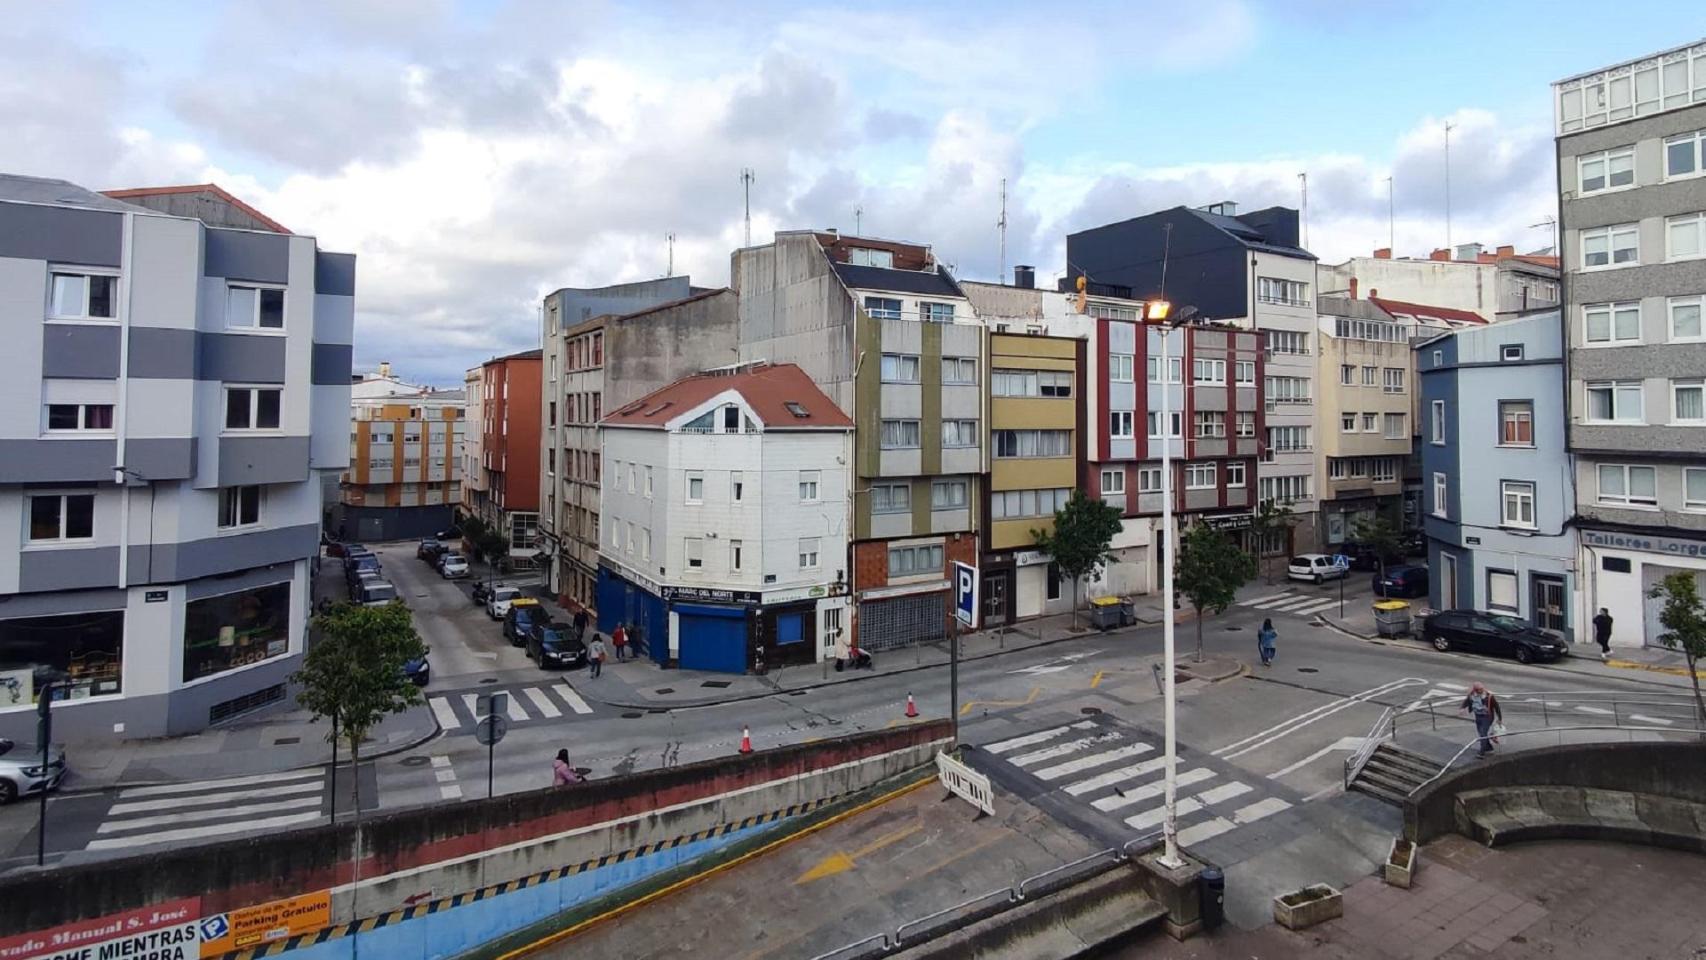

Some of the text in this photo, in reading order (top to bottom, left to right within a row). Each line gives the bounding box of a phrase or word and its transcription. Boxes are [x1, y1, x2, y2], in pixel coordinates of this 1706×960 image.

[1586, 532, 1651, 549] Talleres
[960, 569, 972, 604] P
[51, 920, 122, 947] Manual
[150, 907, 188, 925] José
[235, 914, 279, 930] Parking
[282, 902, 328, 918] Gratuito
[100, 925, 195, 960] MIENTRAS
